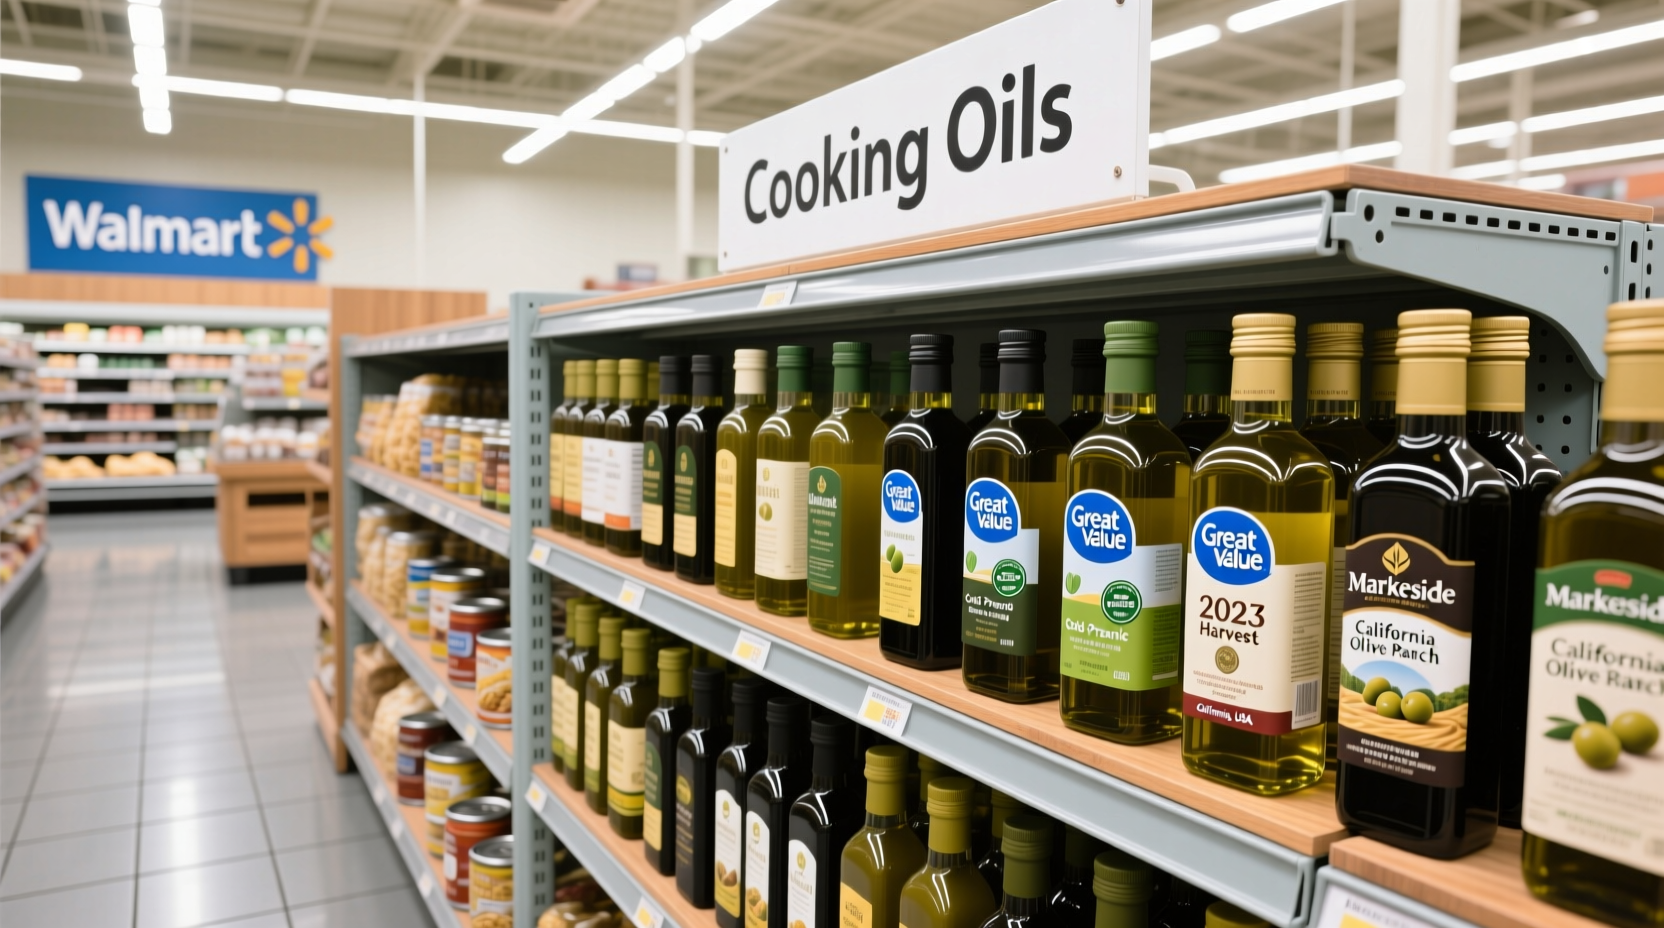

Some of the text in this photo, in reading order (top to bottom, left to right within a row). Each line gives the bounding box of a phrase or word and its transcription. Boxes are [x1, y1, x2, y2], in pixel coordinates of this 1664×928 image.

[745, 64, 1072, 224] Cooking Oils
[43, 198, 263, 259] Walmart
[969, 491, 1008, 515] Great
[977, 511, 1013, 531] Value
[1071, 505, 1120, 531] Great
[1082, 527, 1127, 550] Value
[1201, 522, 1257, 551] Great
[1213, 547, 1264, 571] Value
[1347, 571, 1456, 605] Markeside
[1199, 594, 1265, 628] 2023
[1545, 582, 1664, 625] Markesid
[1199, 620, 1260, 646] Harvest
[1350, 636, 1387, 655] Olive
[1355, 619, 1435, 646] California
[1546, 659, 1601, 684] Olive
